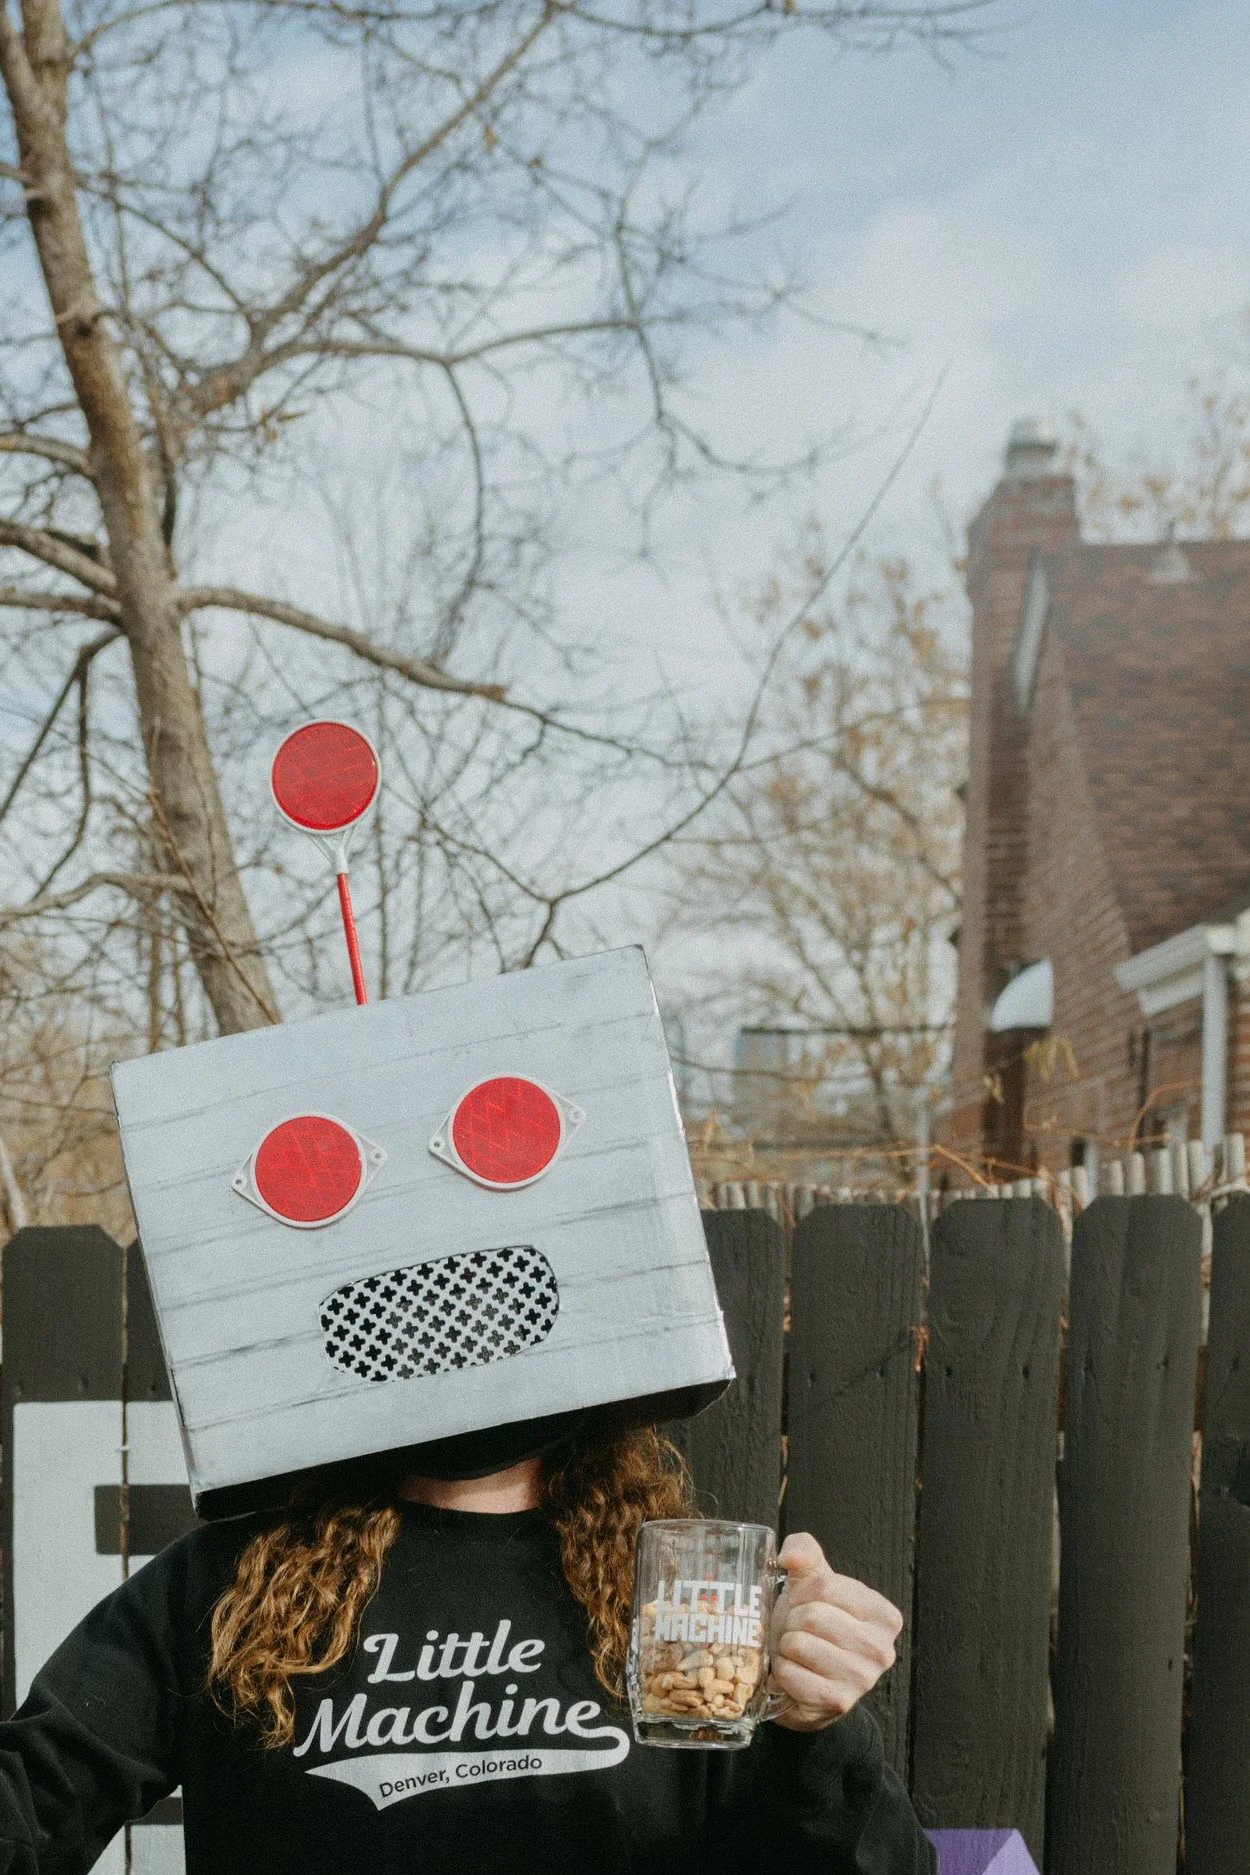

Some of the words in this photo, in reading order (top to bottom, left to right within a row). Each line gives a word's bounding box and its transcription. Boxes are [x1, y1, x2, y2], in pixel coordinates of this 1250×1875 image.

[658, 1580, 762, 1619] LITTLE
[363, 1619, 545, 1684] Little
[654, 1612, 761, 1648] MACHINE
[293, 1680, 604, 1757] Machine
[379, 1766, 450, 1798] Denver,
[455, 1754, 543, 1780] Colorado
